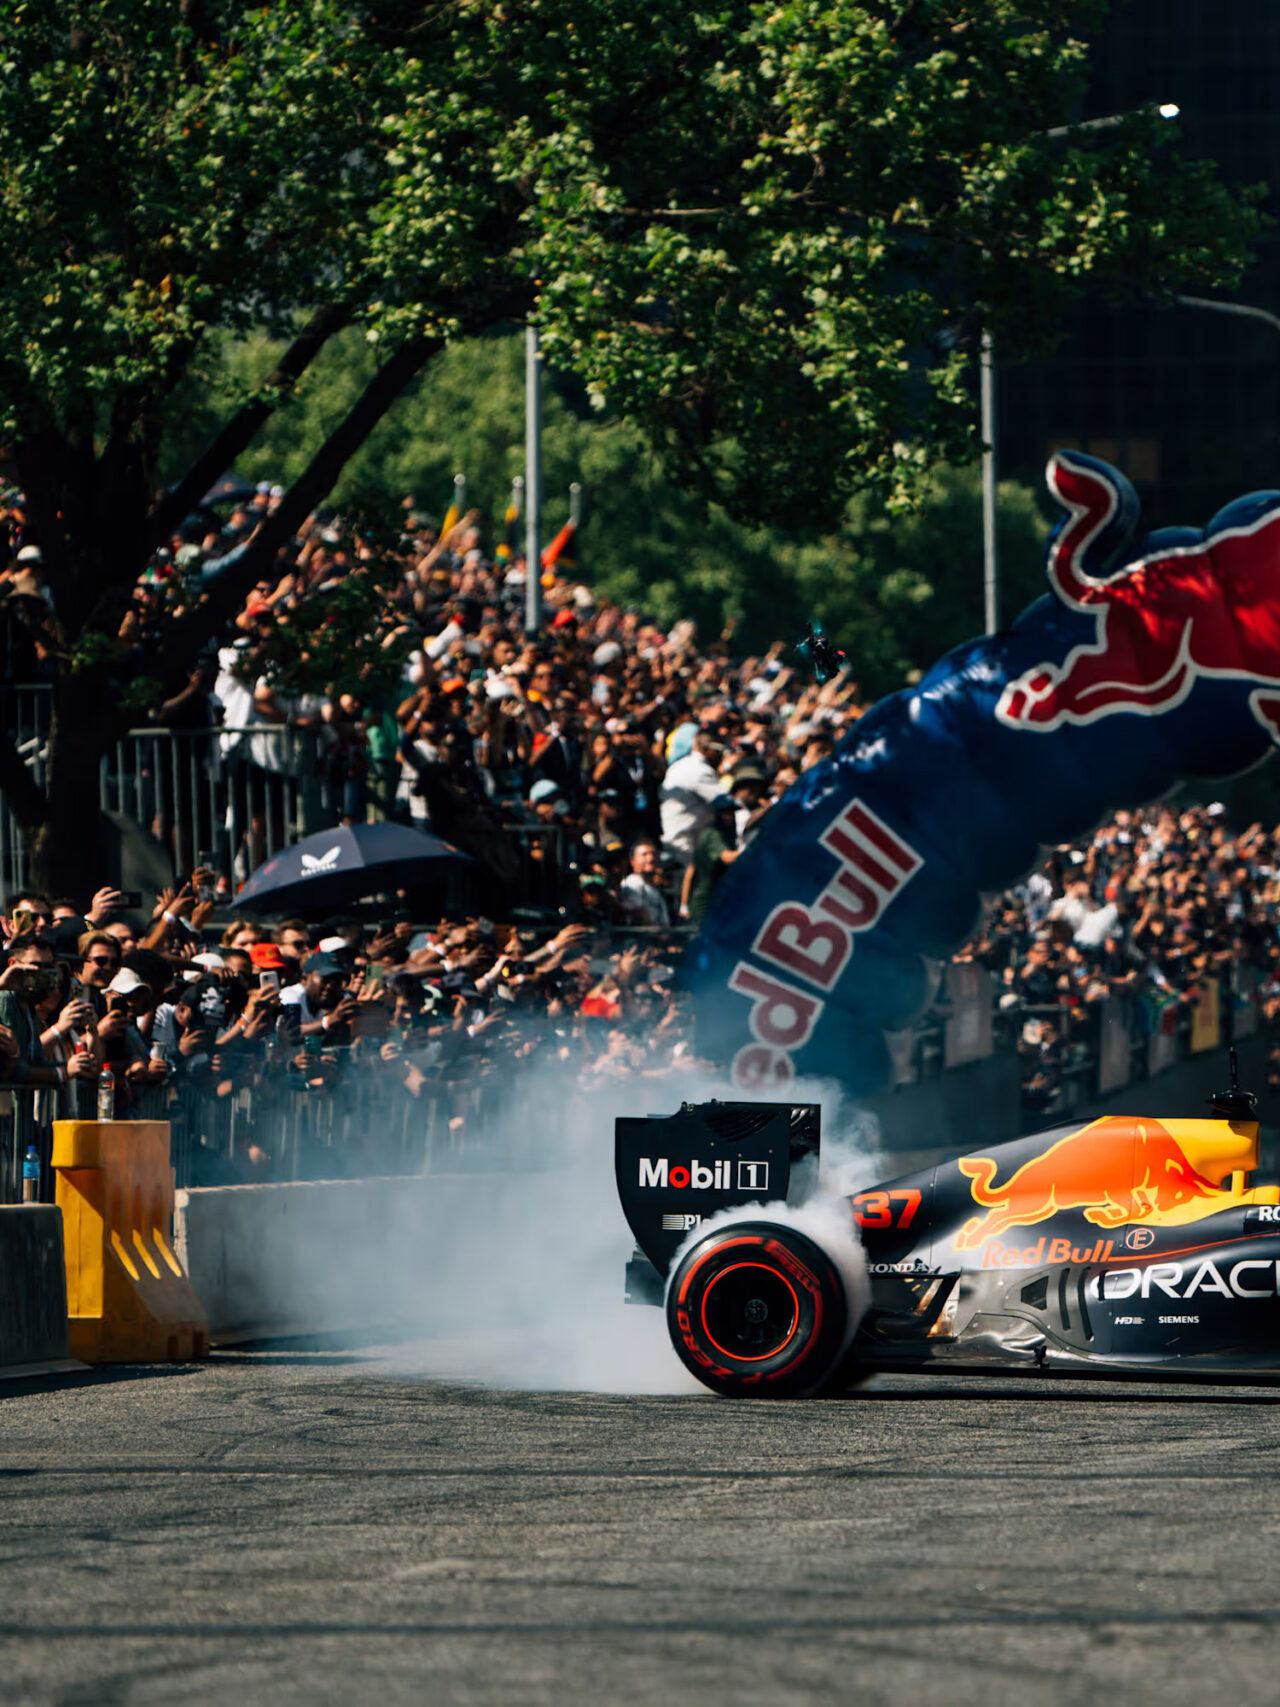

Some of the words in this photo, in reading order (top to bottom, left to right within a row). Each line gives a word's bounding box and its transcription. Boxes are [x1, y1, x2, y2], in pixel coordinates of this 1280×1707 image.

[751, 797, 925, 993] Bull
[728, 961, 825, 1093] ed
[638, 1157, 731, 1190] Mobil
[852, 1188, 922, 1229] 37
[982, 1236, 1047, 1268] Red
[1047, 1237, 1115, 1264] Bull
[1158, 1315, 1200, 1324] SIEMENS
